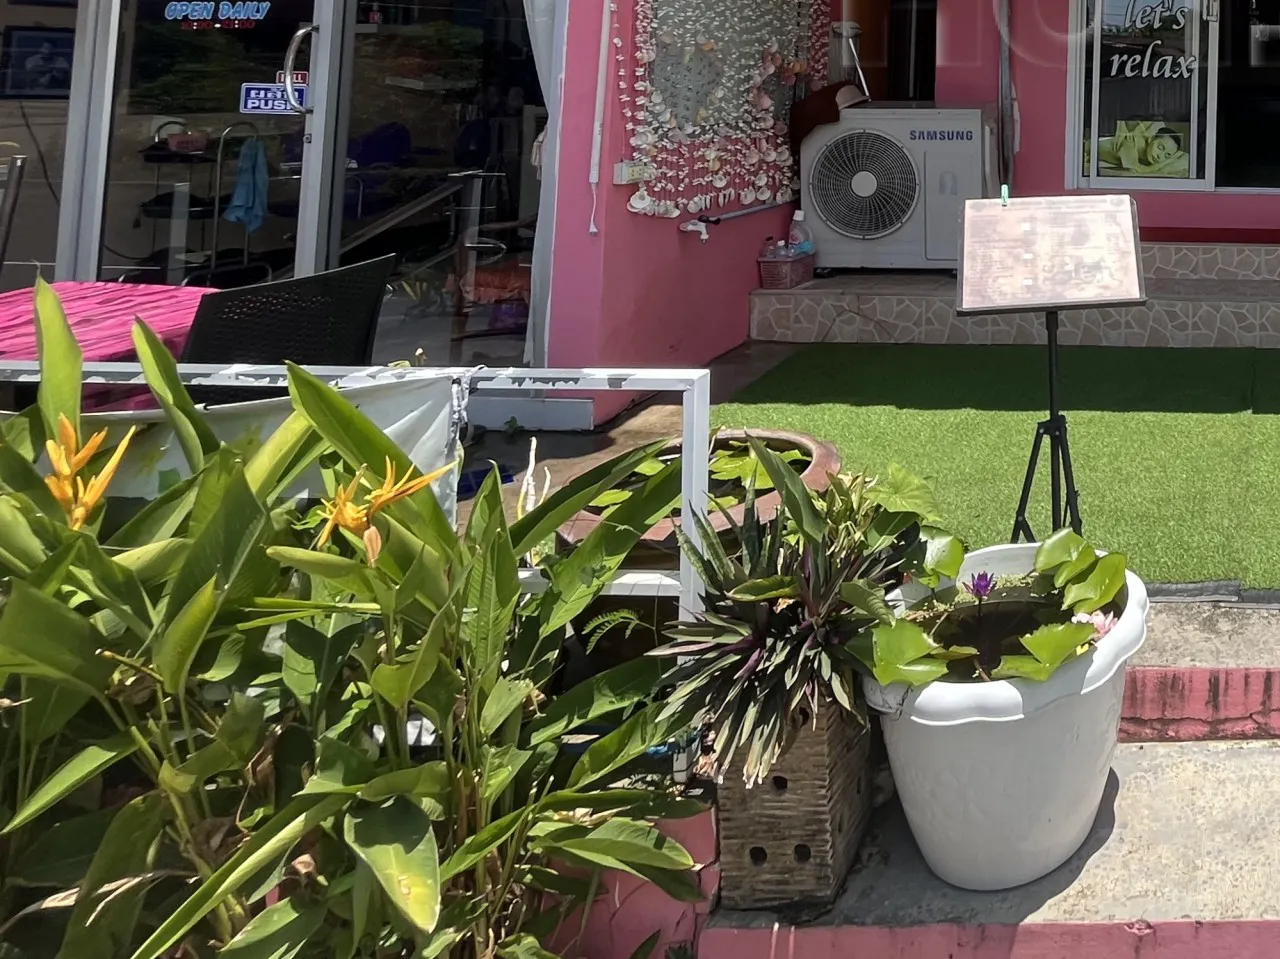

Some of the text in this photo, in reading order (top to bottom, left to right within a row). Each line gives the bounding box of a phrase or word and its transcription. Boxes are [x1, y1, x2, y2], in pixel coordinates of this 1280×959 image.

[164, 1, 271, 20] OPEN DAILY
[1110, 40, 1197, 79] relax
[909, 129, 974, 141] SAMSUNG
